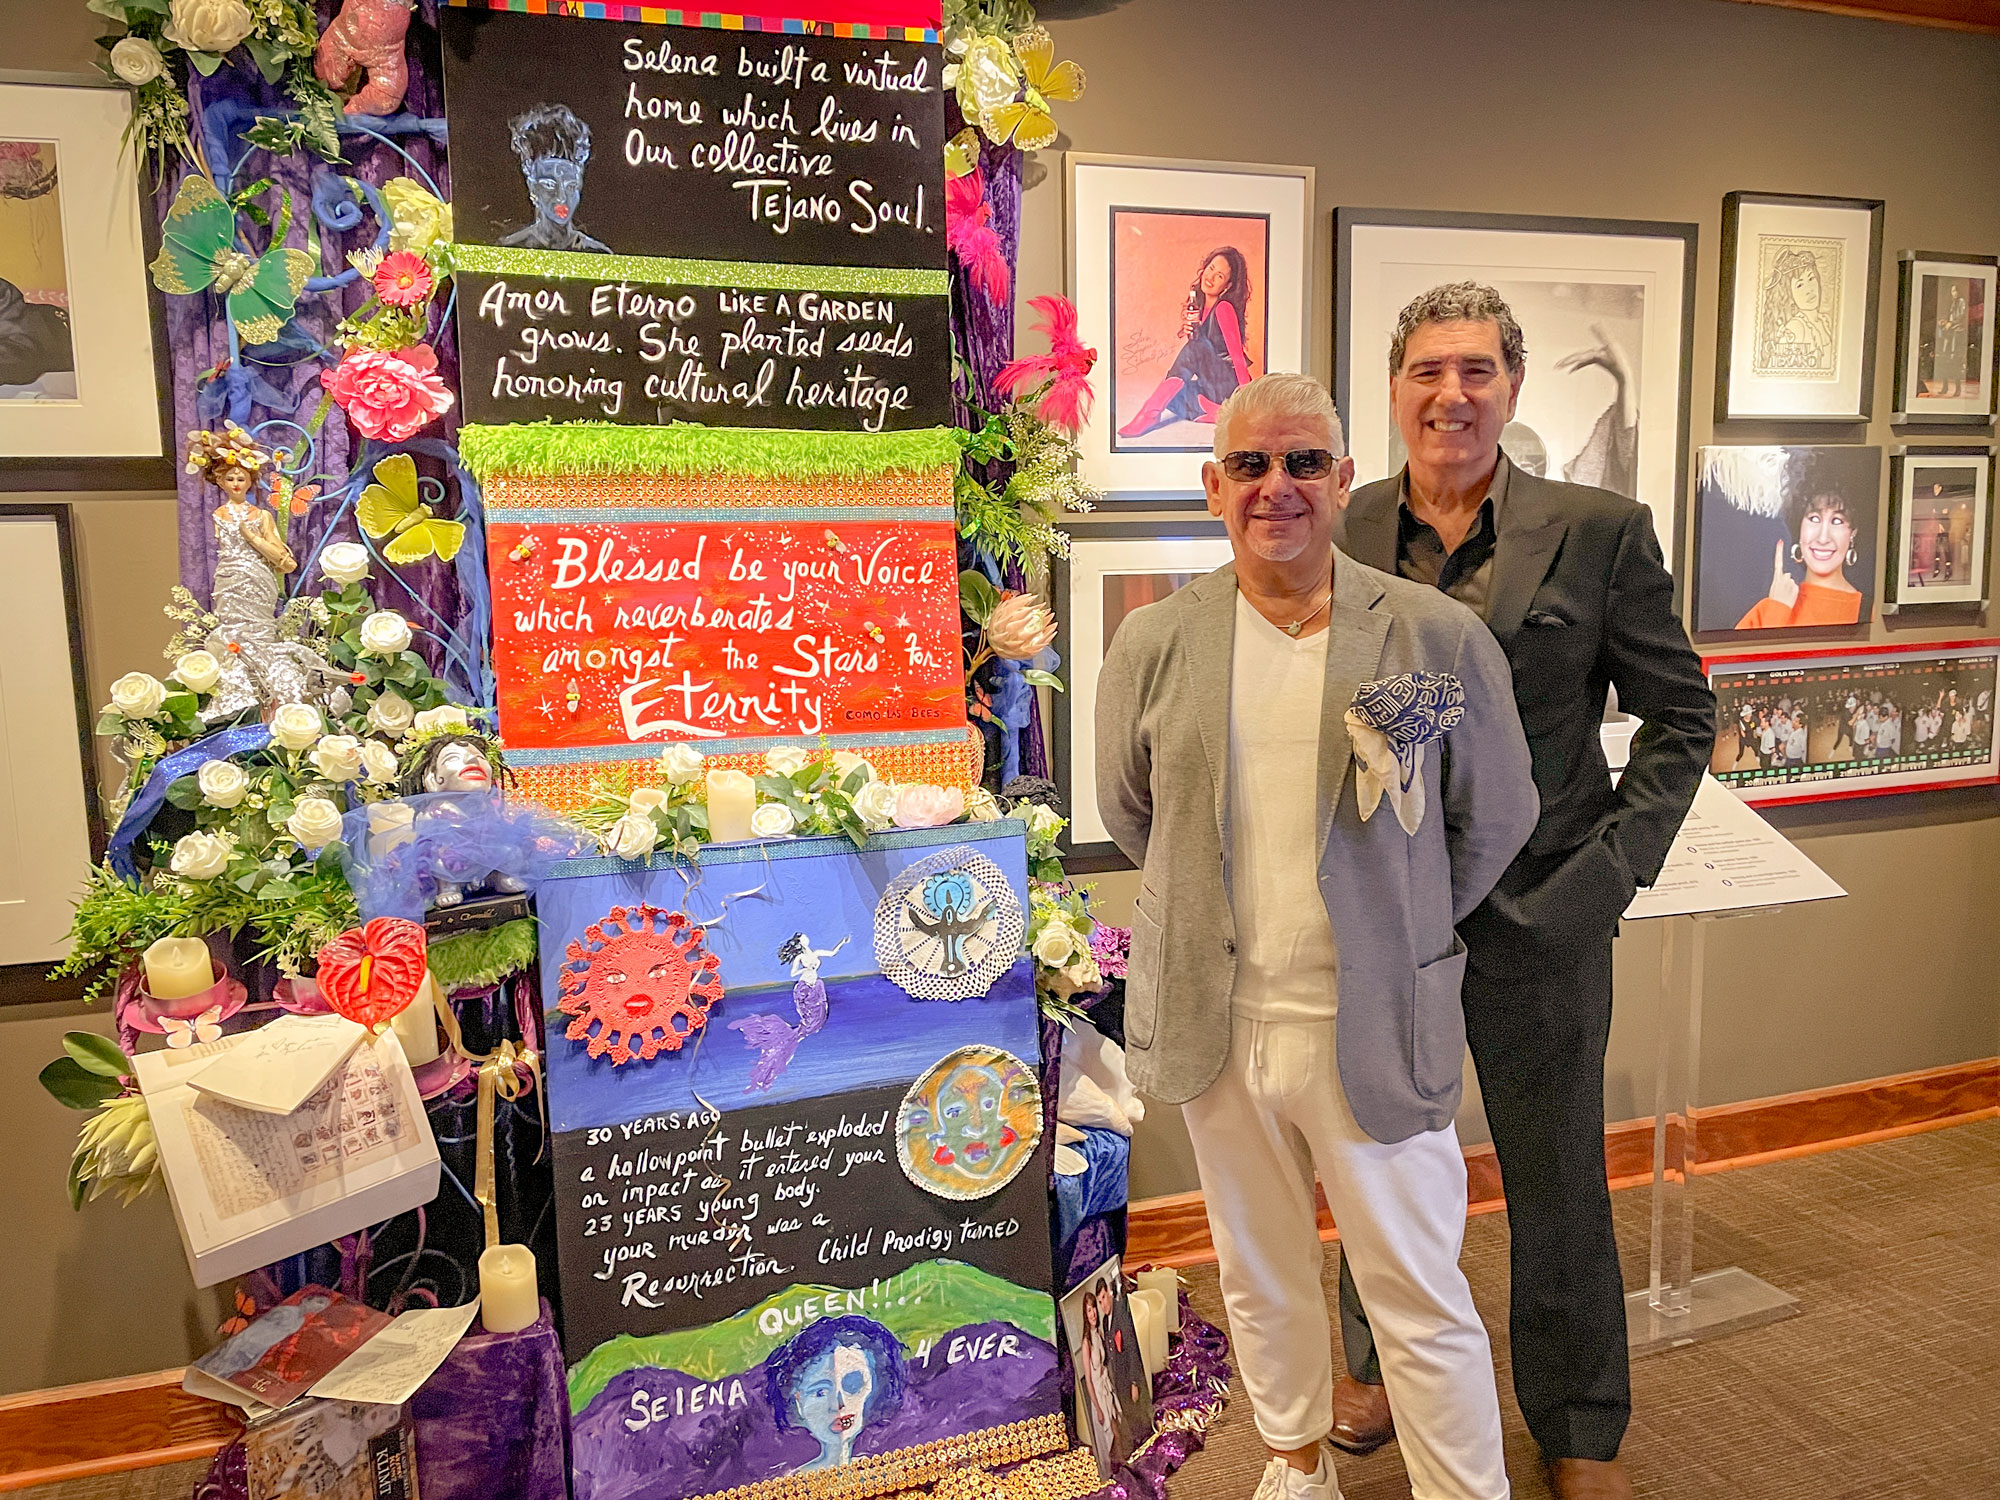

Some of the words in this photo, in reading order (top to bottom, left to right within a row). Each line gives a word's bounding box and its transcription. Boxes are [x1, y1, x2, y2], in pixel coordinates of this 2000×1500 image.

[623, 38, 718, 76] Selena
[737, 45, 809, 90] built
[810, 62, 831, 83] a
[843, 50, 934, 92] virtual
[624, 81, 703, 124] home
[722, 92, 800, 135] which
[810, 95, 878, 143] lives
[891, 113, 921, 150] in
[625, 128, 679, 170] Our
[691, 130, 835, 177] collective
[848, 180, 934, 234] Soul.
[478, 281, 571, 327] Amor
[590, 282, 696, 323] Eterno
[775, 293, 792, 316] A
[798, 293, 894, 325] GARDEN
[519, 327, 623, 363] grows.
[638, 322, 702, 362] She
[720, 317, 826, 369] planted
[835, 322, 913, 358] seeds
[491, 356, 623, 415] honoring
[644, 358, 776, 409] cultural
[786, 363, 913, 433] heritage
[551, 535, 706, 590] Blessed
[728, 548, 768, 583] be
[776, 557, 845, 602] your
[850, 536, 935, 586] Voice
[513, 598, 594, 634] which
[614, 593, 795, 633] reverberates
[542, 631, 685, 685] amongst
[721, 638, 759, 671] the
[772, 634, 879, 678] Stars
[618, 670, 832, 742] Eternity
[845, 710, 881, 720] COMO
[886, 709, 902, 719] LAS
[911, 707, 940, 718] BEES
[580, 1167, 595, 1182] a
[740, 1120, 803, 1152] bullet
[806, 1110, 889, 1148] exploded
[586, 1128, 613, 1146] 30
[687, 1110, 721, 1130] AGO
[581, 1192, 609, 1209] on
[622, 1168, 698, 1207] impact
[738, 1152, 765, 1181] it
[764, 1149, 834, 1178] entered
[837, 1148, 887, 1177] your
[584, 1214, 613, 1237] 23
[695, 1192, 760, 1222] young
[774, 1176, 821, 1208] body.
[766, 1217, 803, 1236] was
[811, 1212, 831, 1227] a
[620, 1246, 796, 1309] Resurrection.
[817, 1227, 873, 1264] Child
[882, 1226, 952, 1252] Prodigy
[915, 1337, 934, 1369] 4
[946, 1332, 1026, 1365] EVER
[375, 1447, 393, 1497] KLIMT
